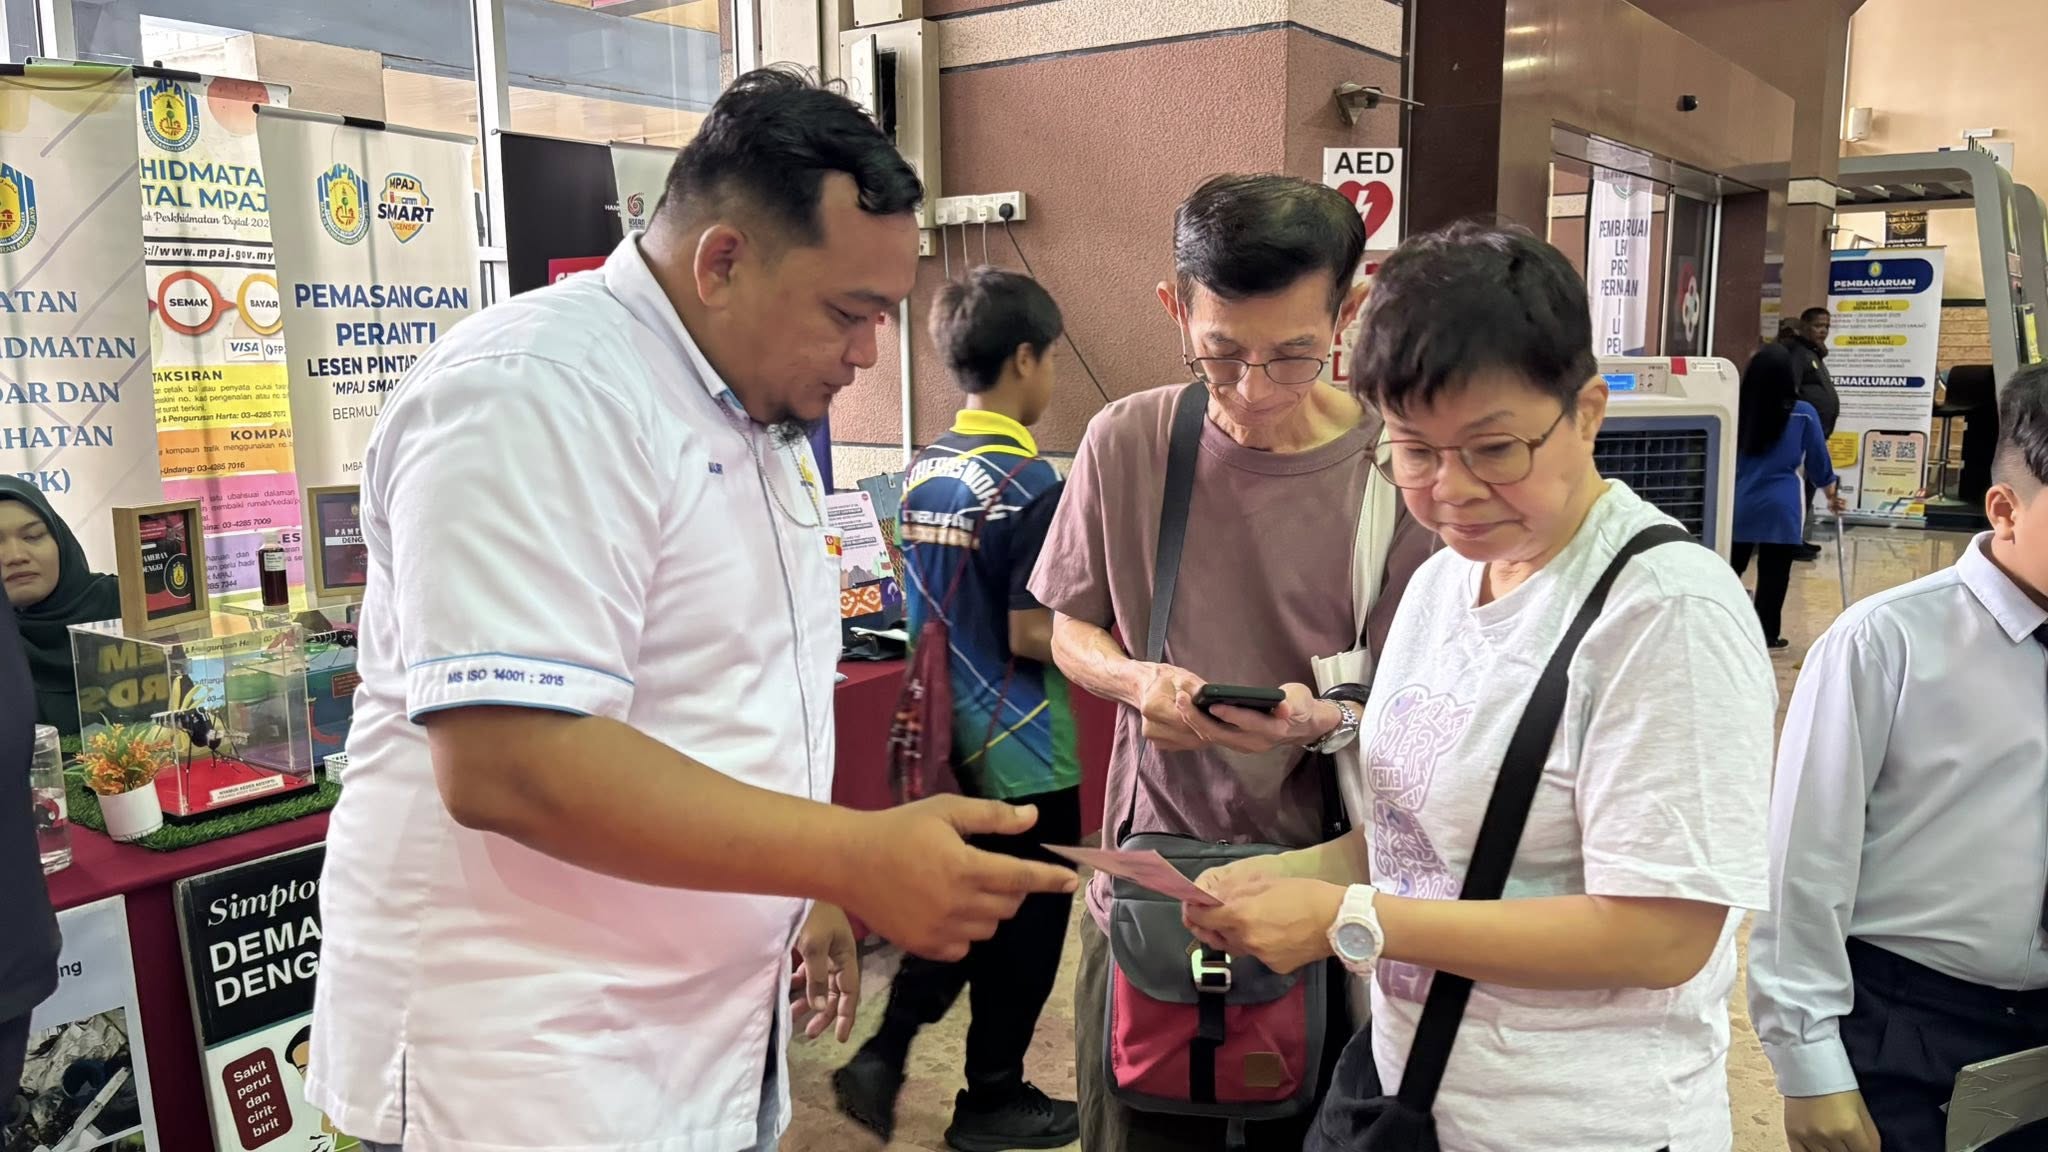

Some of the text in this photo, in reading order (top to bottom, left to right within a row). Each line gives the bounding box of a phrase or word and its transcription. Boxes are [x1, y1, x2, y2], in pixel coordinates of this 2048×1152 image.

[140, 158, 264, 188] HIDMATA
[1334, 152, 1394, 174] AED
[389, 178, 415, 190] MPAJ
[142, 185, 270, 212] TAL MPAJ
[378, 203, 434, 222] SMART
[1834, 279, 1916, 288] PEMBAHARUAN
[169, 298, 208, 307] SEMAK
[250, 299, 279, 308] BAYAR
[295, 283, 468, 309] PEMASANGAN
[336, 322, 436, 347] PERANTI
[0, 336, 136, 359] DMATAN
[230, 342, 259, 352] VISA
[152, 370, 222, 383] TAKSIRAN
[307, 357, 362, 377] LESEN
[56, 381, 119, 403] DAN
[168, 414, 214, 422] Pengurusan
[0, 426, 113, 449] HATAN
[448, 671, 463, 684] MS
[467, 669, 487, 682] ISO
[493, 668, 525, 683] 14001
[539, 673, 564, 686] 2015
[208, 879, 319, 927] Simpto
[209, 916, 322, 973] DEMA
[215, 951, 319, 1008] DENG
[233, 1060, 267, 1082] Sakit
[237, 1073, 272, 1100] perut
[246, 1092, 271, 1109] dan
[247, 1105, 277, 1124] cirit-
[252, 1117, 280, 1137] birit
